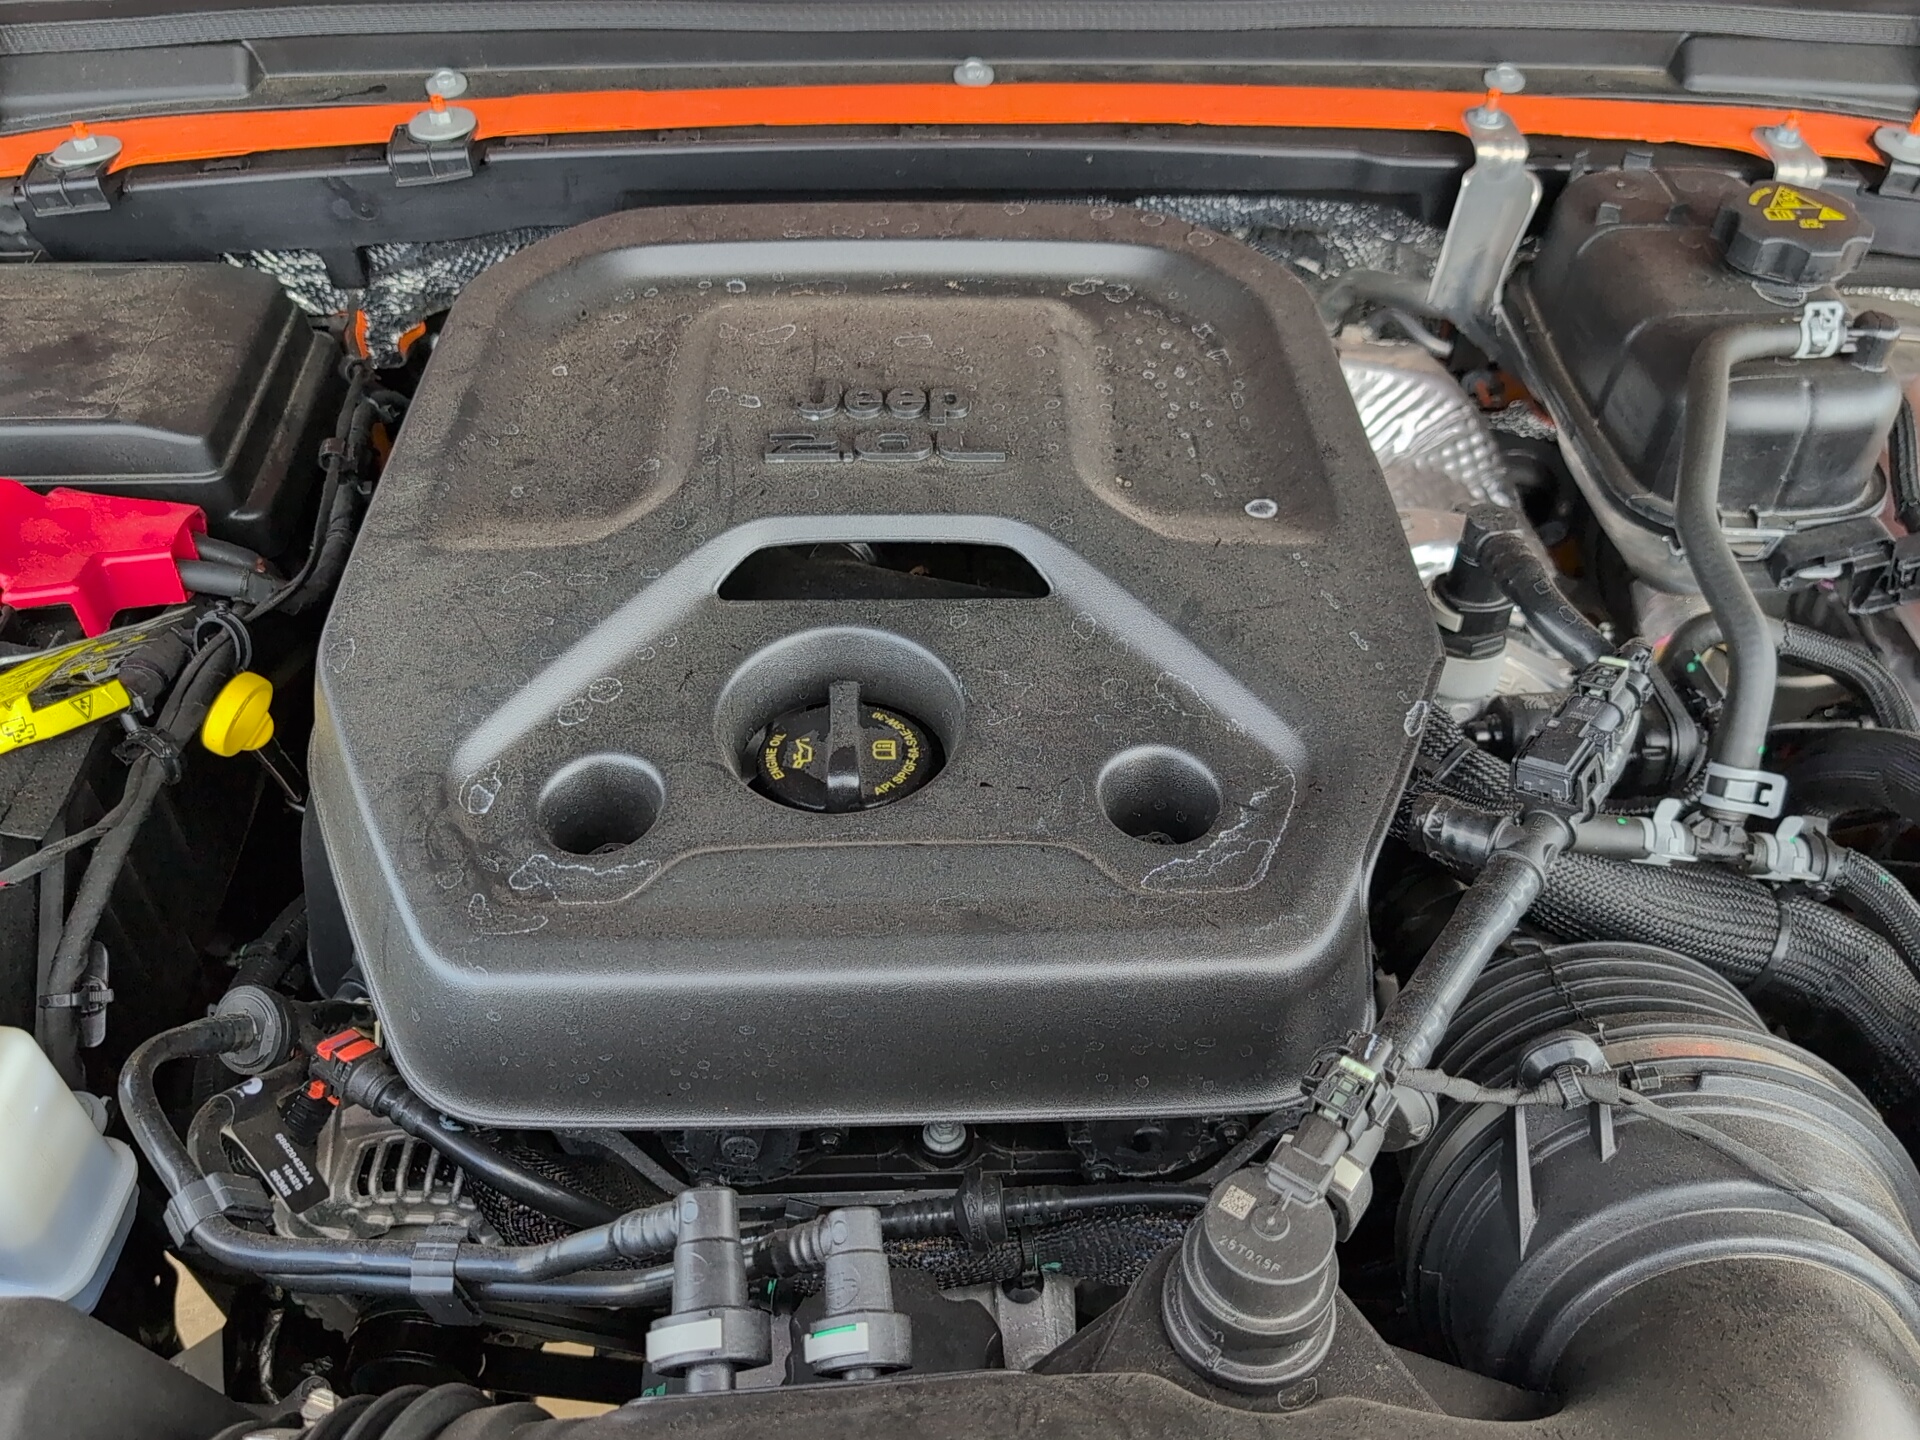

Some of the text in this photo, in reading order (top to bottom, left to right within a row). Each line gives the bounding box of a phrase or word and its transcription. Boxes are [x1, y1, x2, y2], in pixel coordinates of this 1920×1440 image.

[798, 381, 973, 426] Jeep
[765, 733, 787, 780] ENGINE OIL
[874, 781, 896, 796] API
